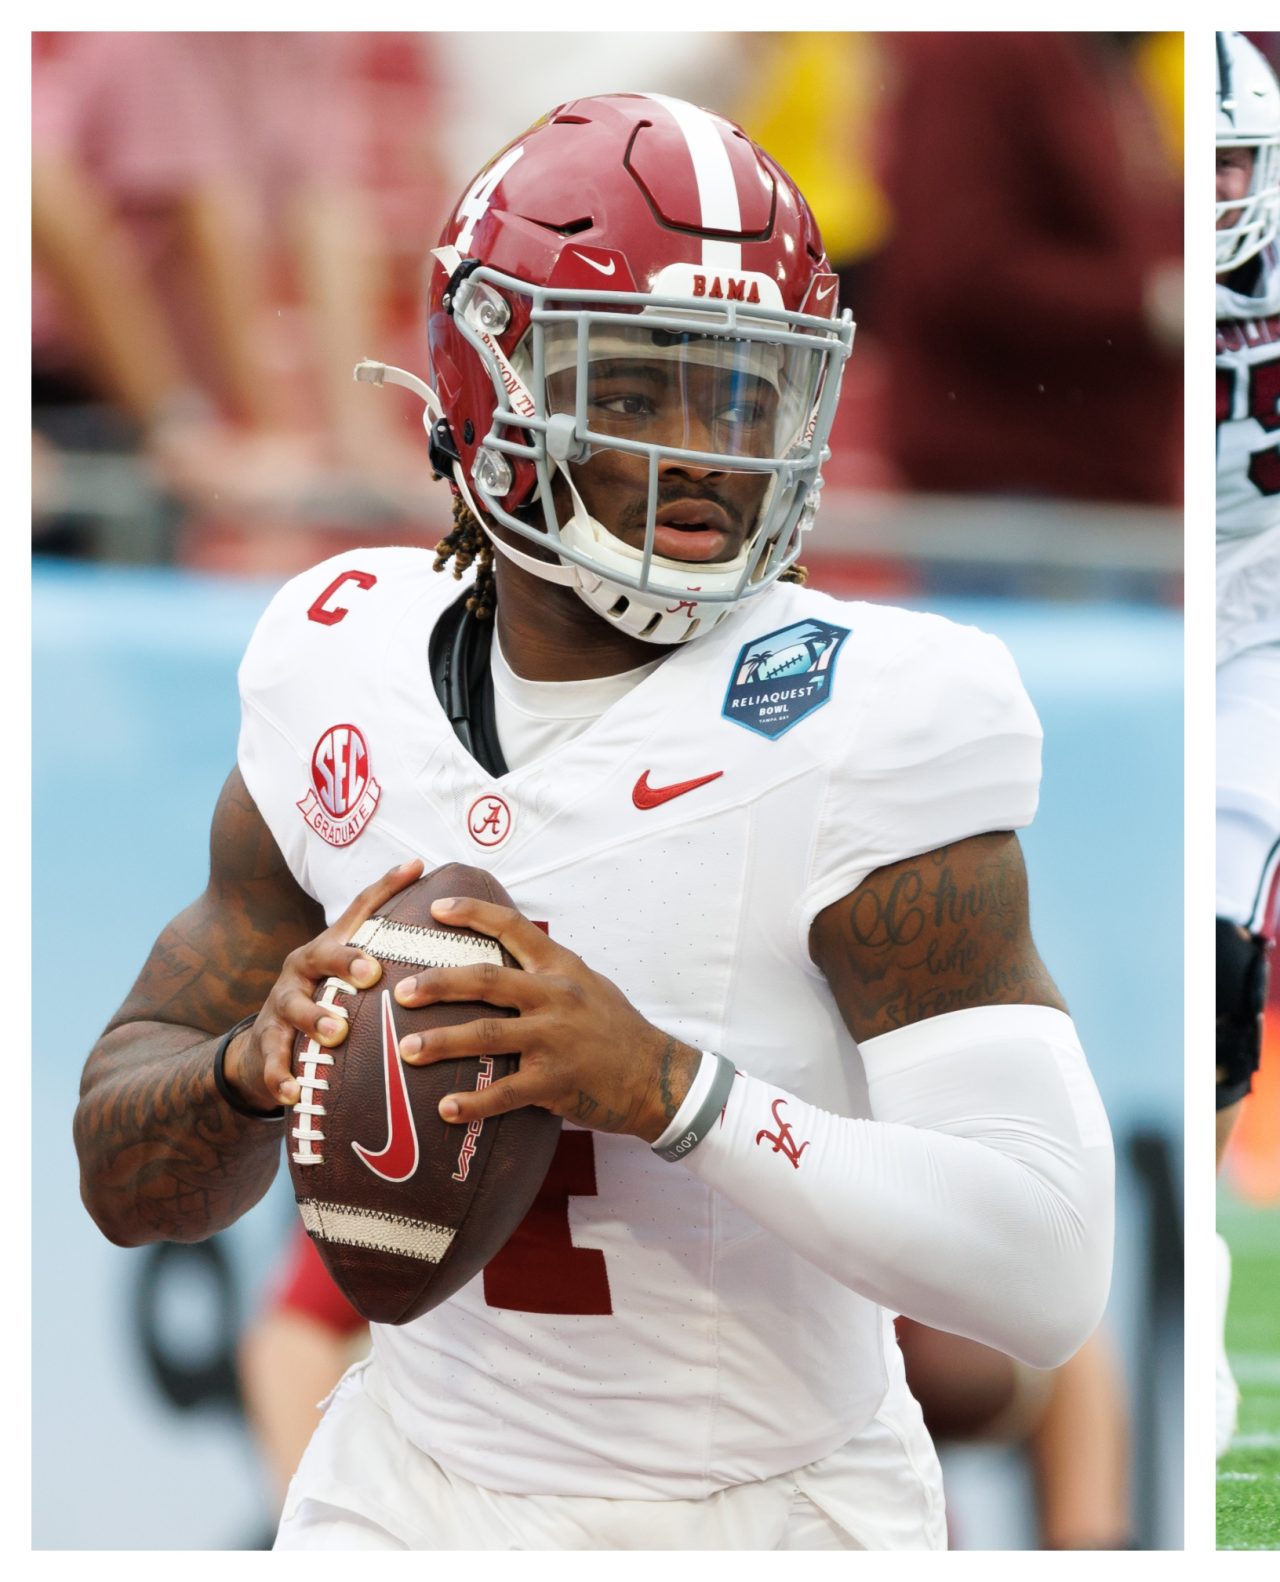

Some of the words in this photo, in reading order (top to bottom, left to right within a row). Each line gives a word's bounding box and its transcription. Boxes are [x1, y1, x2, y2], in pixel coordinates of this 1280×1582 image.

[454, 145, 524, 254] 4
[692, 274, 761, 304] BAMA
[307, 569, 377, 626] C
[732, 686, 814, 708] RELIAQUEST
[759, 704, 789, 716] BOWL
[314, 728, 367, 814] SEC
[313, 803, 370, 844] GRADUATE
[473, 802, 501, 834] A
[452, 1118, 483, 1181] VAPO
[675, 1131, 698, 1154] GOD
